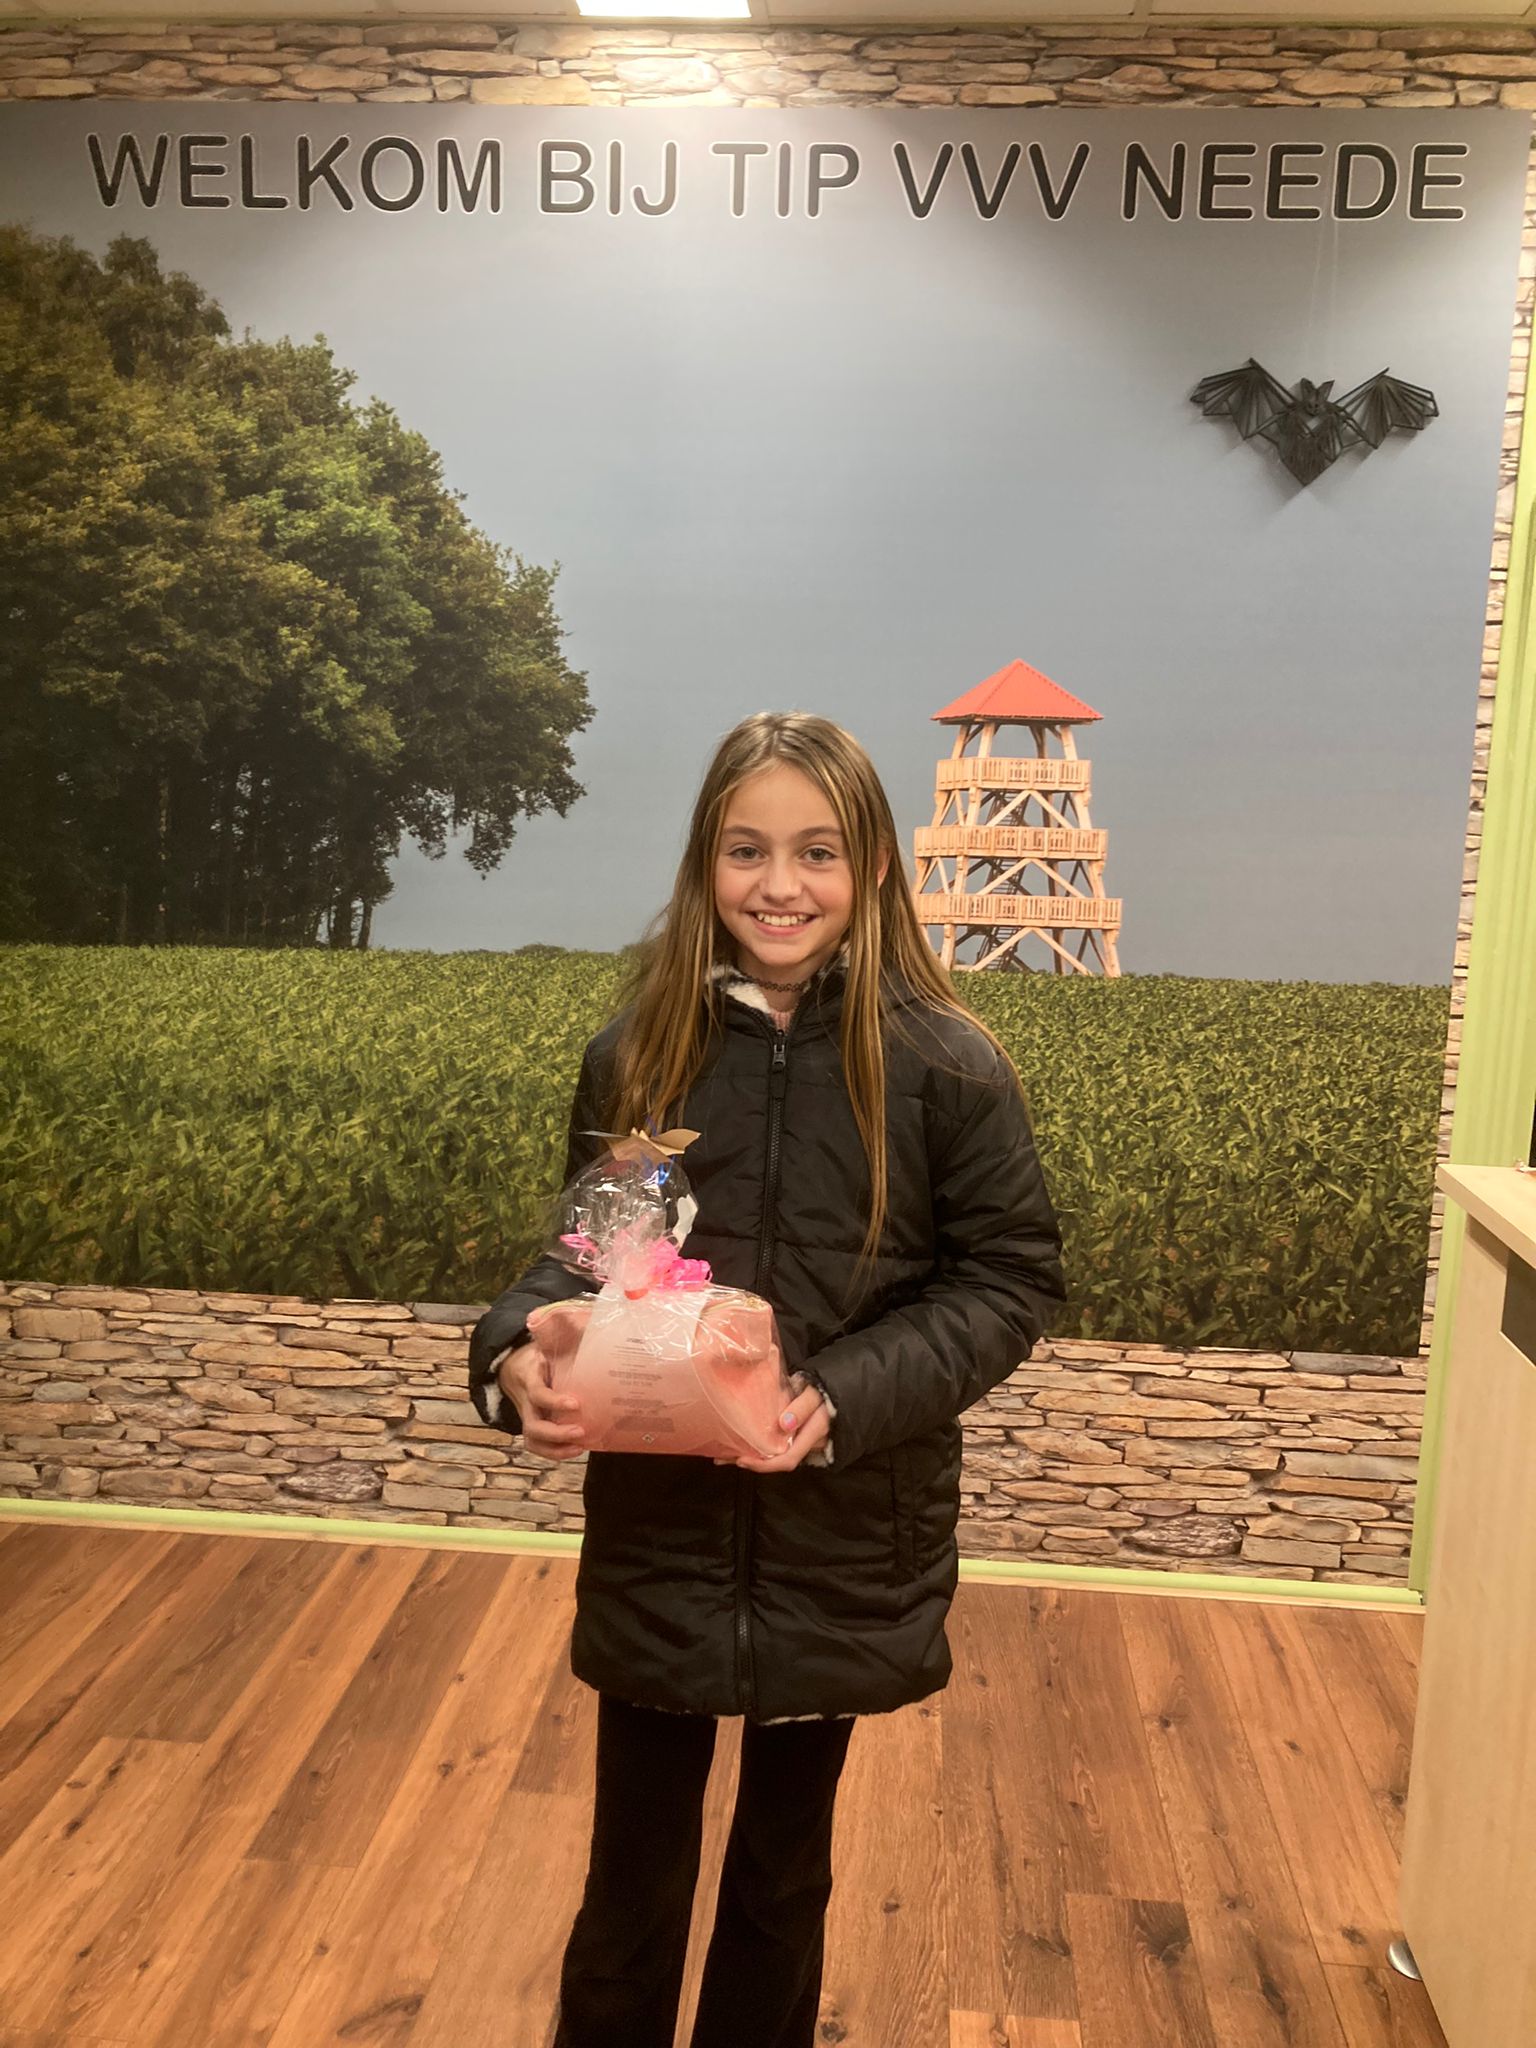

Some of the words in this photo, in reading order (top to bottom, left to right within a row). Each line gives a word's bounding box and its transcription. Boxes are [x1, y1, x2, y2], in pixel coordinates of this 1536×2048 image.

[86, 131, 502, 216] WELKOM
[537, 137, 680, 219] BIJ
[709, 140, 861, 220] TIP
[892, 139, 1092, 222] VVV
[1120, 141, 1470, 222] NEEDE
